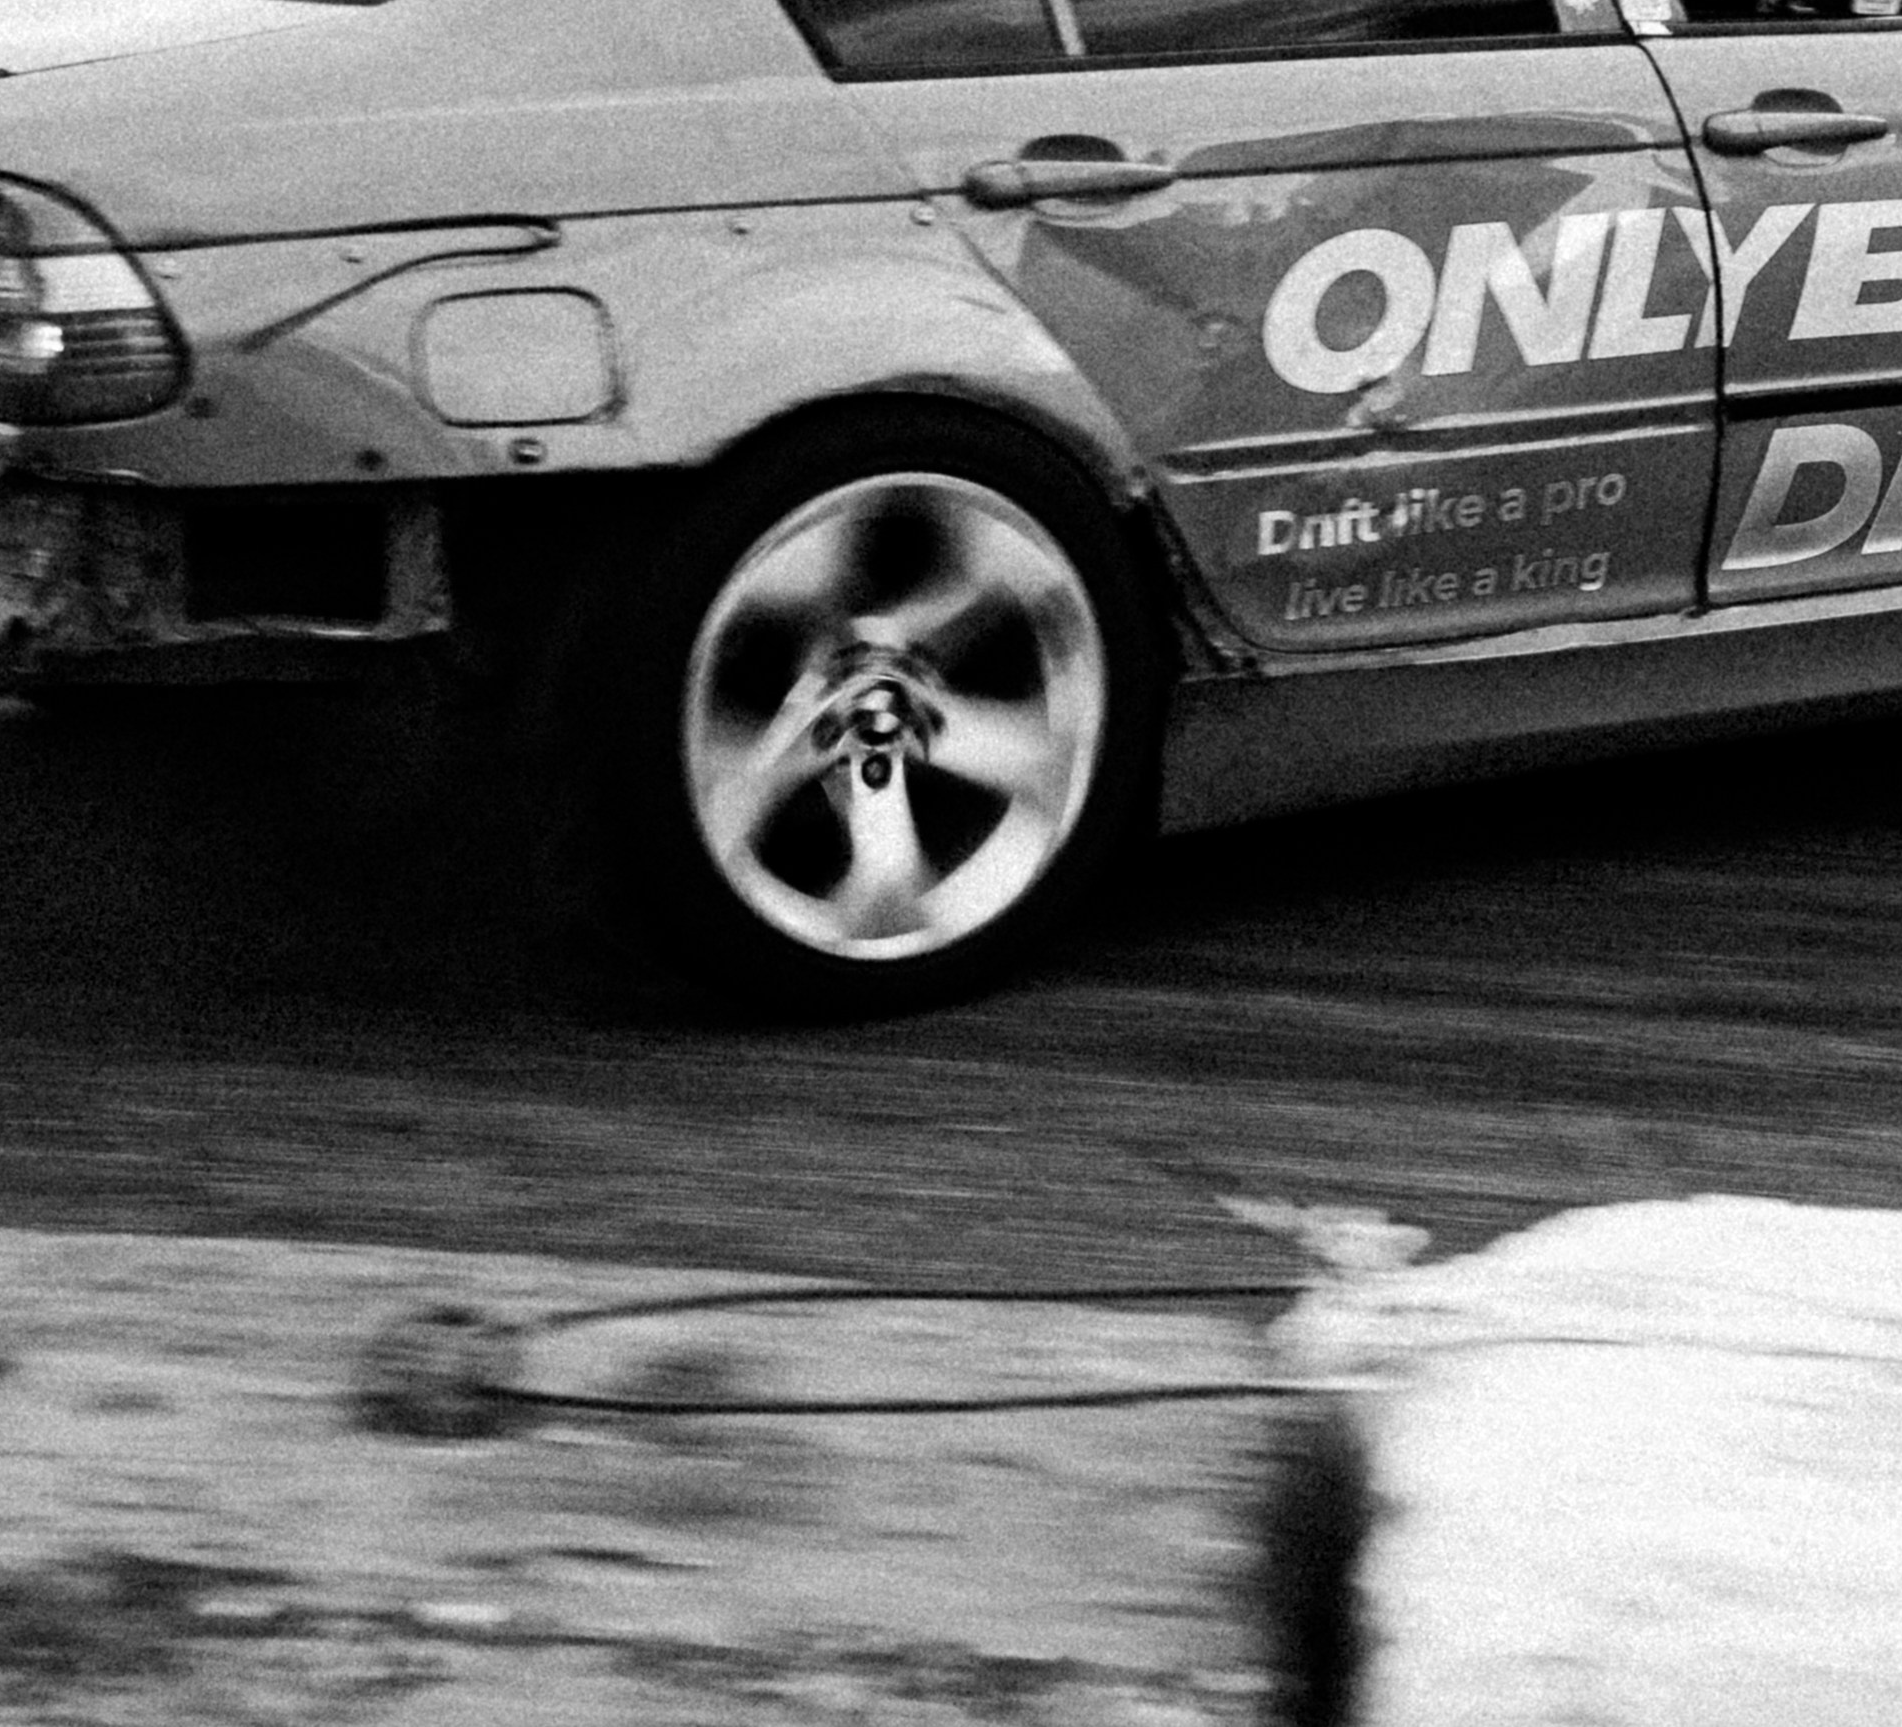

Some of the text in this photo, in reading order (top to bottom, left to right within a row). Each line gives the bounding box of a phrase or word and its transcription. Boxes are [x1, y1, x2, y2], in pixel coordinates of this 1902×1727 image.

[1391, 487, 1487, 537] like
[1498, 487, 1527, 522] a
[1540, 472, 1628, 526] pro
[1284, 547, 1612, 621] live like a king
